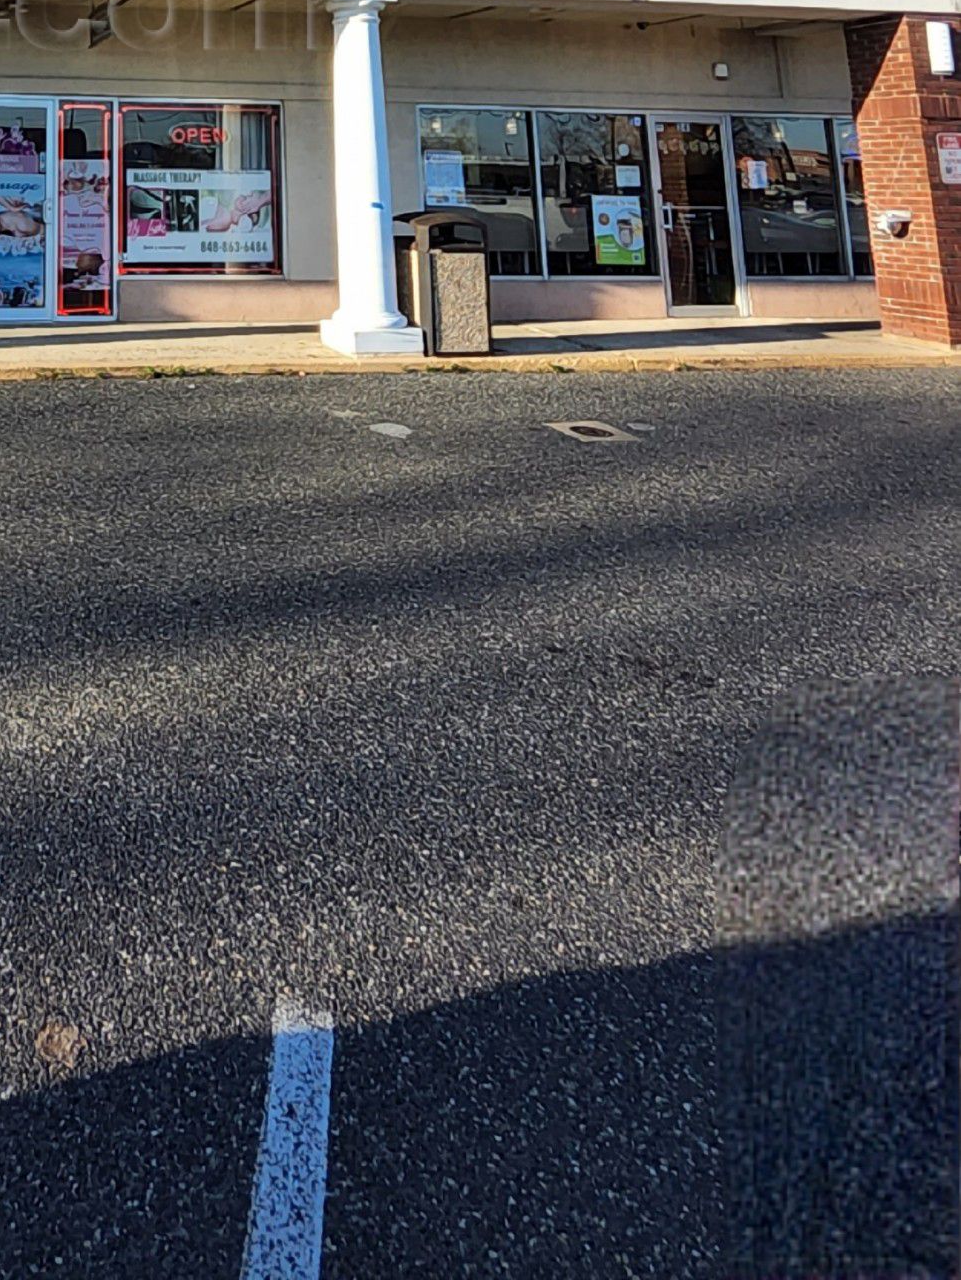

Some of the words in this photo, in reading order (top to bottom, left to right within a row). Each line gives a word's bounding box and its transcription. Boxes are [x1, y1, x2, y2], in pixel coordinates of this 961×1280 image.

[170, 127, 227, 145] OPEN
[133, 171, 167, 183] MASSAGE
[169, 172, 202, 184] THERAPY
